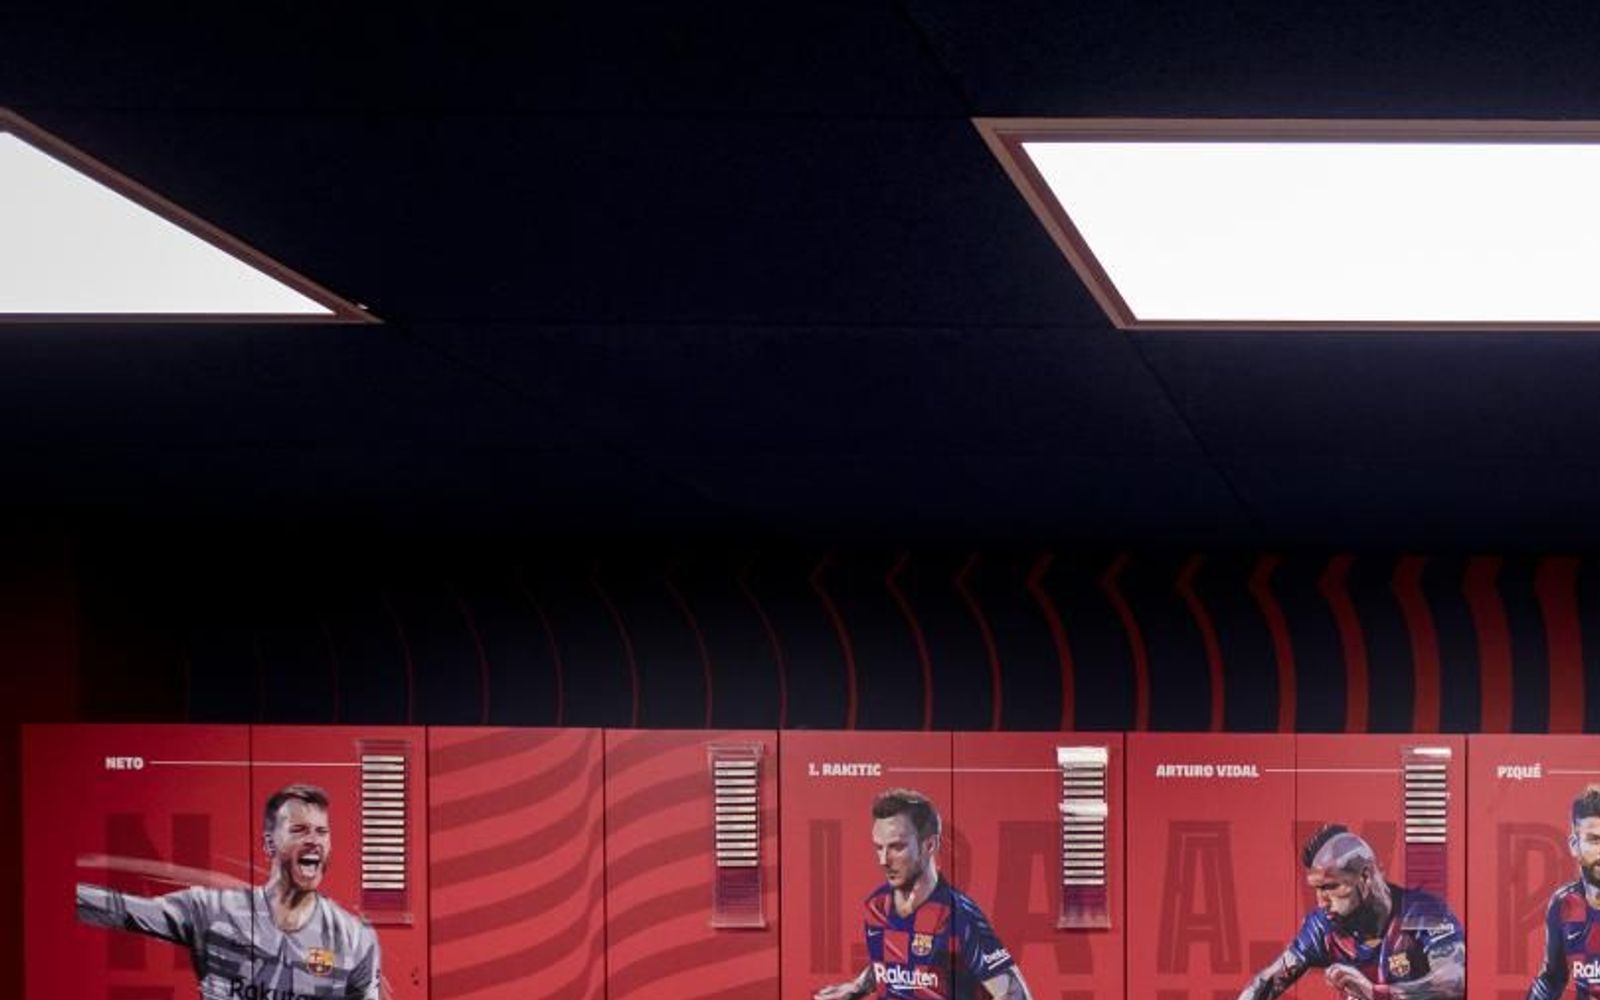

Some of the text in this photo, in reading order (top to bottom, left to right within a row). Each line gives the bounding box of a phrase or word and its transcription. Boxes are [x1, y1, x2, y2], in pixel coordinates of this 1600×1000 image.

[105, 757, 144, 770] NETO
[822, 763, 882, 776] RAKITIC
[1156, 764, 1260, 777] ARTURO VIDAL
[1497, 763, 1542, 779] PIQUÉ
[873, 962, 938, 987] Rakuten
